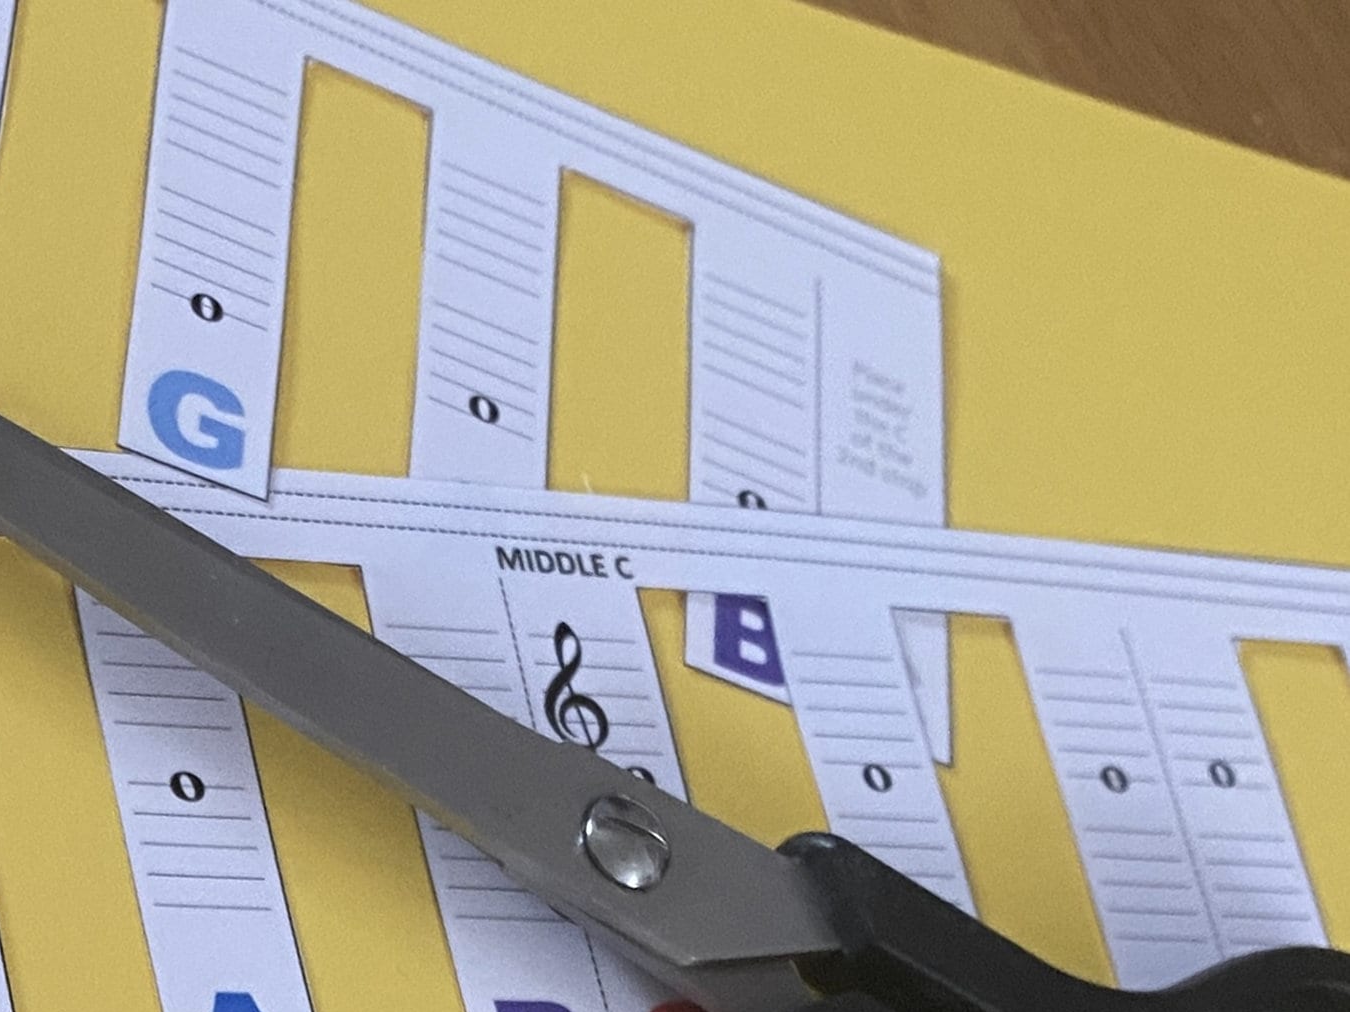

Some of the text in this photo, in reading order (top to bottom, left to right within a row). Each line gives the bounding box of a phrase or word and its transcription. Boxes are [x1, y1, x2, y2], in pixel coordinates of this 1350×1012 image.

[146, 368, 247, 471] G
[494, 545, 634, 580] MIDDLE C
[714, 593, 785, 687] B
